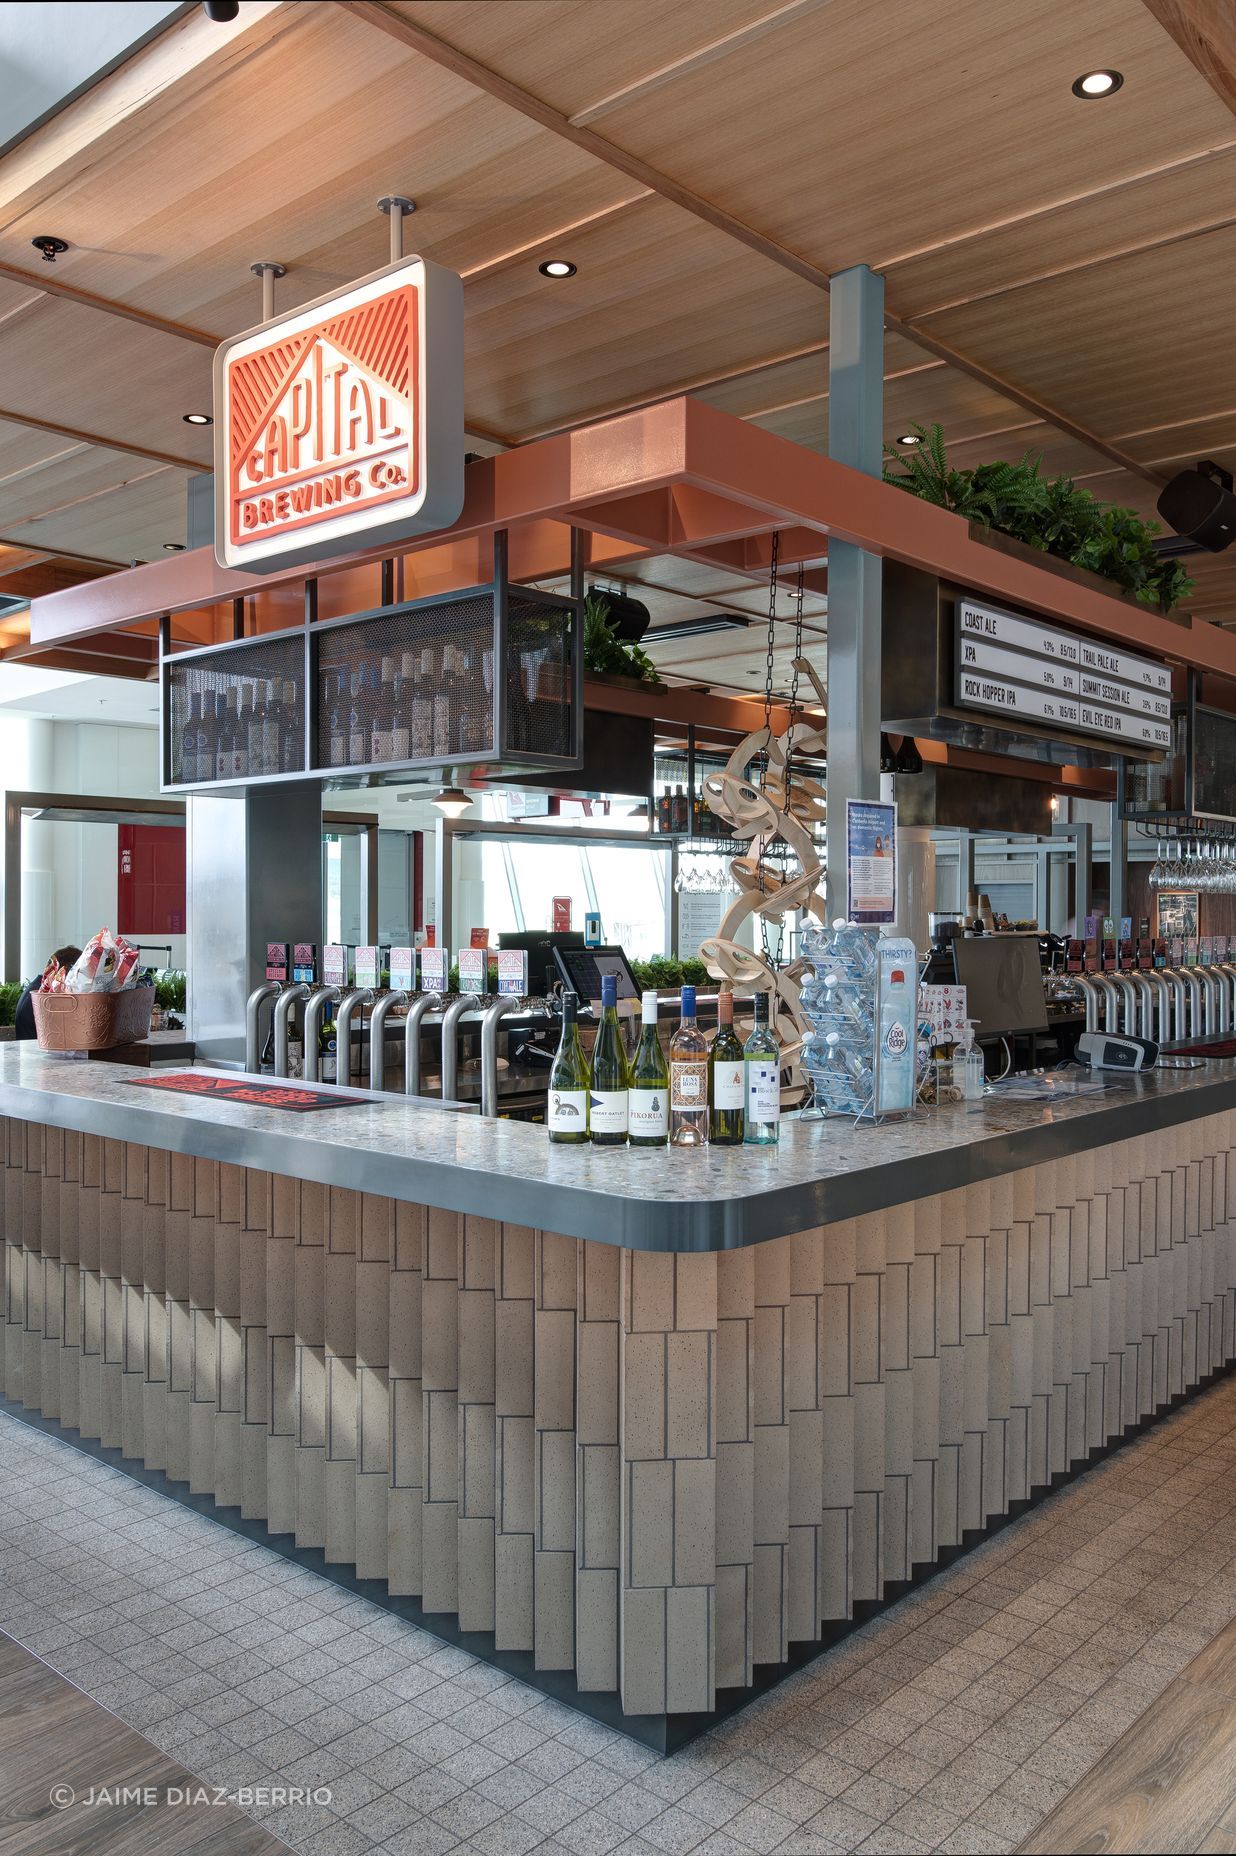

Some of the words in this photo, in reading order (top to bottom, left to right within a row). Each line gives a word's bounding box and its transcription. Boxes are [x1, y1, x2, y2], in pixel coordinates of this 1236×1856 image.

[246, 343, 402, 483] CAPITAL
[243, 469, 361, 528] BREWING
[369, 460, 406, 490] CO.
[965, 612, 983, 630] COAST
[985, 618, 997, 635] ALE
[965, 646, 976, 662] XPA
[1083, 649, 1096, 666] TRAIL
[1097, 654, 1109, 670] PALE
[1109, 658, 1119, 673] ALE
[964, 680, 981, 698] ROCK
[982, 684, 1006, 703] HOPPER
[1006, 689, 1016, 706] IPA
[1082, 679, 1101, 697] SUMMIT
[1102, 684, 1121, 702] SESSION
[1121, 691, 1130, 705] ALE
[1082, 709, 1094, 724] EVIL
[1094, 712, 1104, 727] EYE
[1104, 715, 1114, 730] RED
[1114, 718, 1122, 731] IPA
[882, 950, 912, 959] THIRSTY?
[889, 1038, 905, 1049] Ridge
[890, 1030, 904, 1038] Cool
